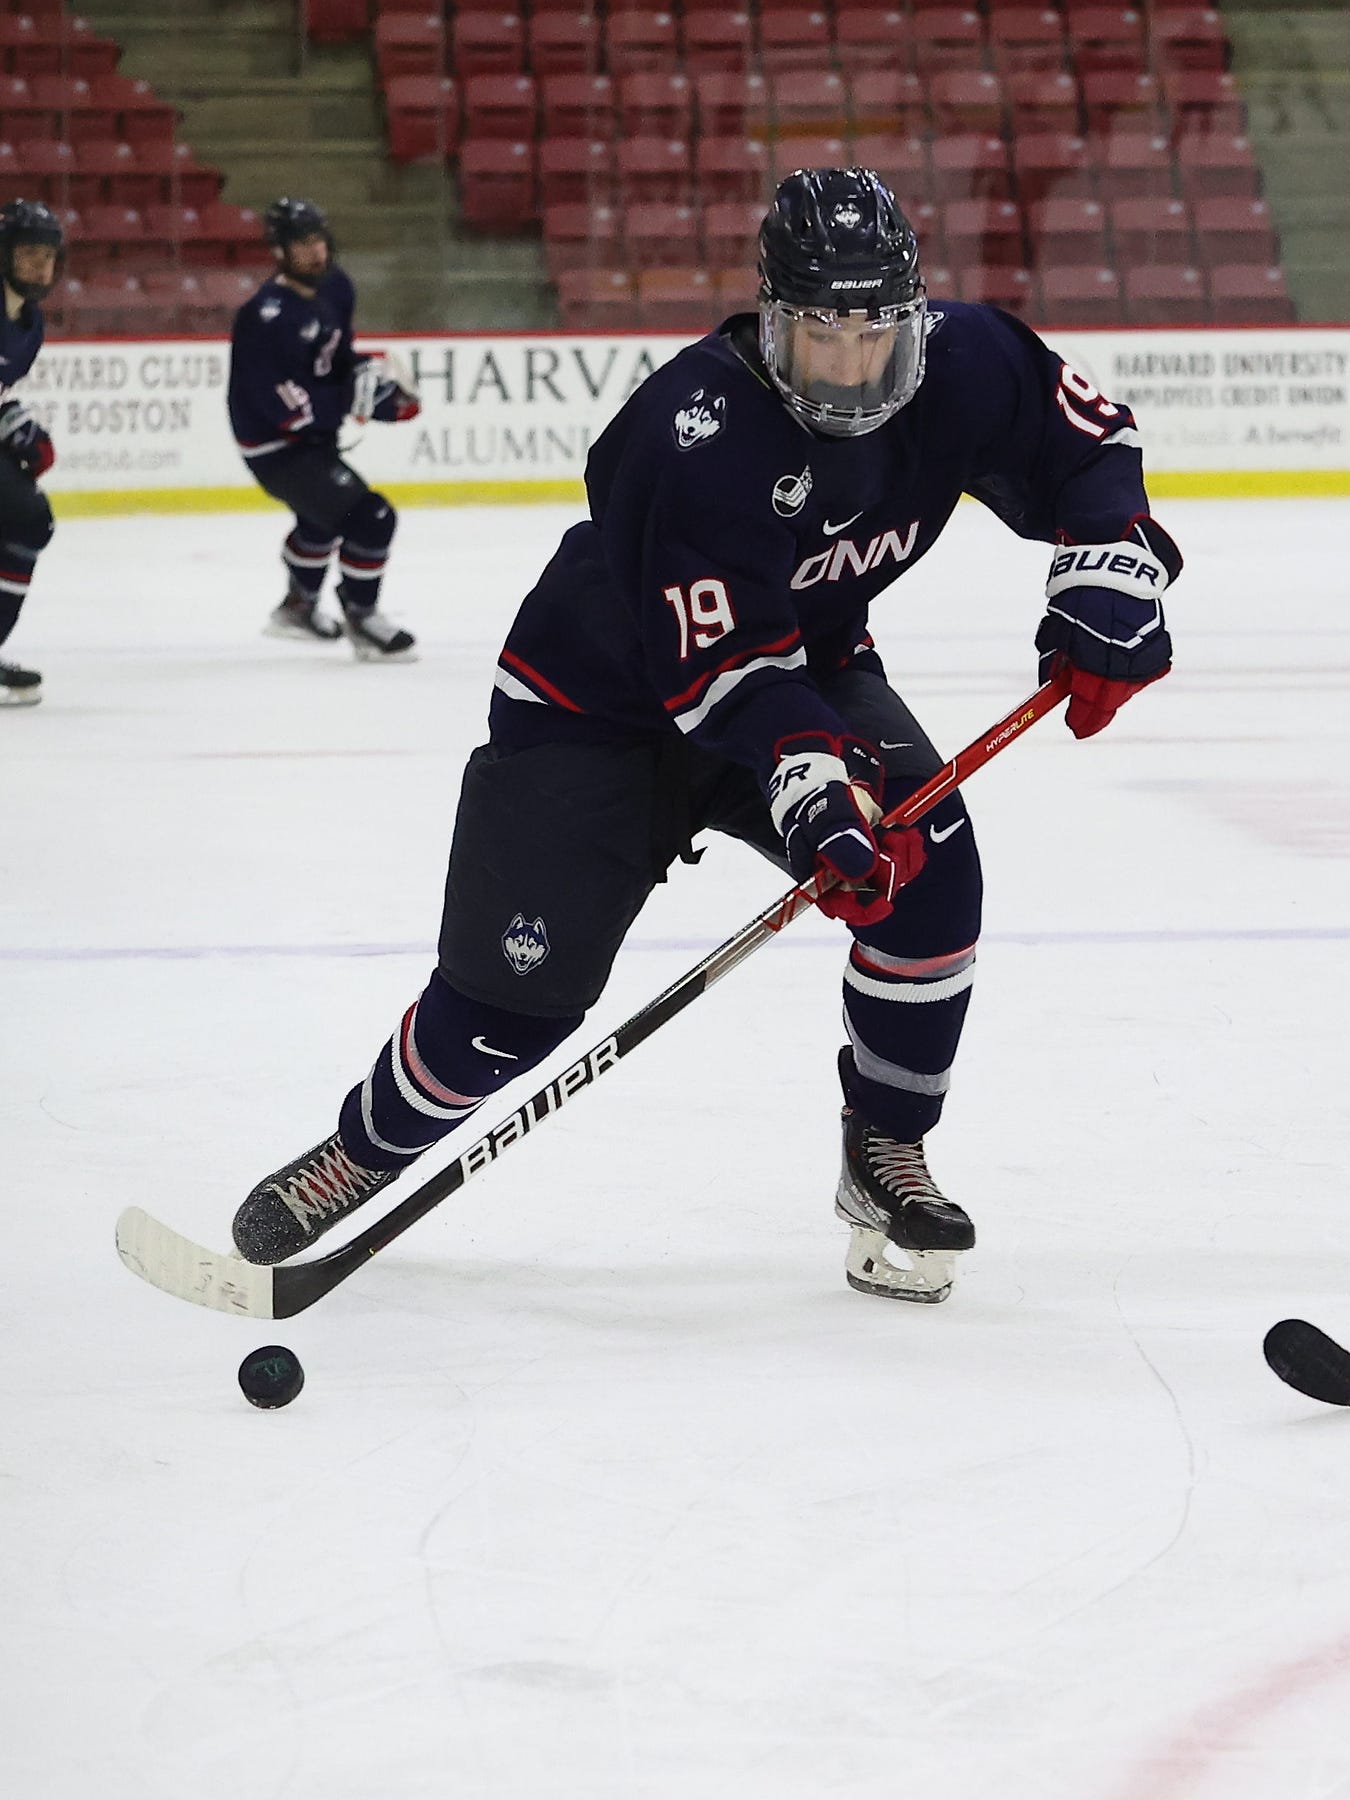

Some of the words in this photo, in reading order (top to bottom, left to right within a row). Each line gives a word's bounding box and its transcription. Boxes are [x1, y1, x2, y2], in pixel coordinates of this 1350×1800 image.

[830, 278, 884, 291] BAUER
[139, 356, 223, 388] CLUB
[408, 347, 656, 404] HARVA
[1113, 353, 1215, 377] HARVARD
[1222, 351, 1348, 377] UNIVERSITY
[67, 401, 191, 434] BOSTON
[1057, 362, 1120, 439] 19
[790, 519, 920, 591] ONN
[1053, 551, 1159, 587] AUER
[662, 577, 738, 661] 19
[985, 708, 1035, 753] HYPERLITE
[459, 1035, 622, 1182] BAUER
